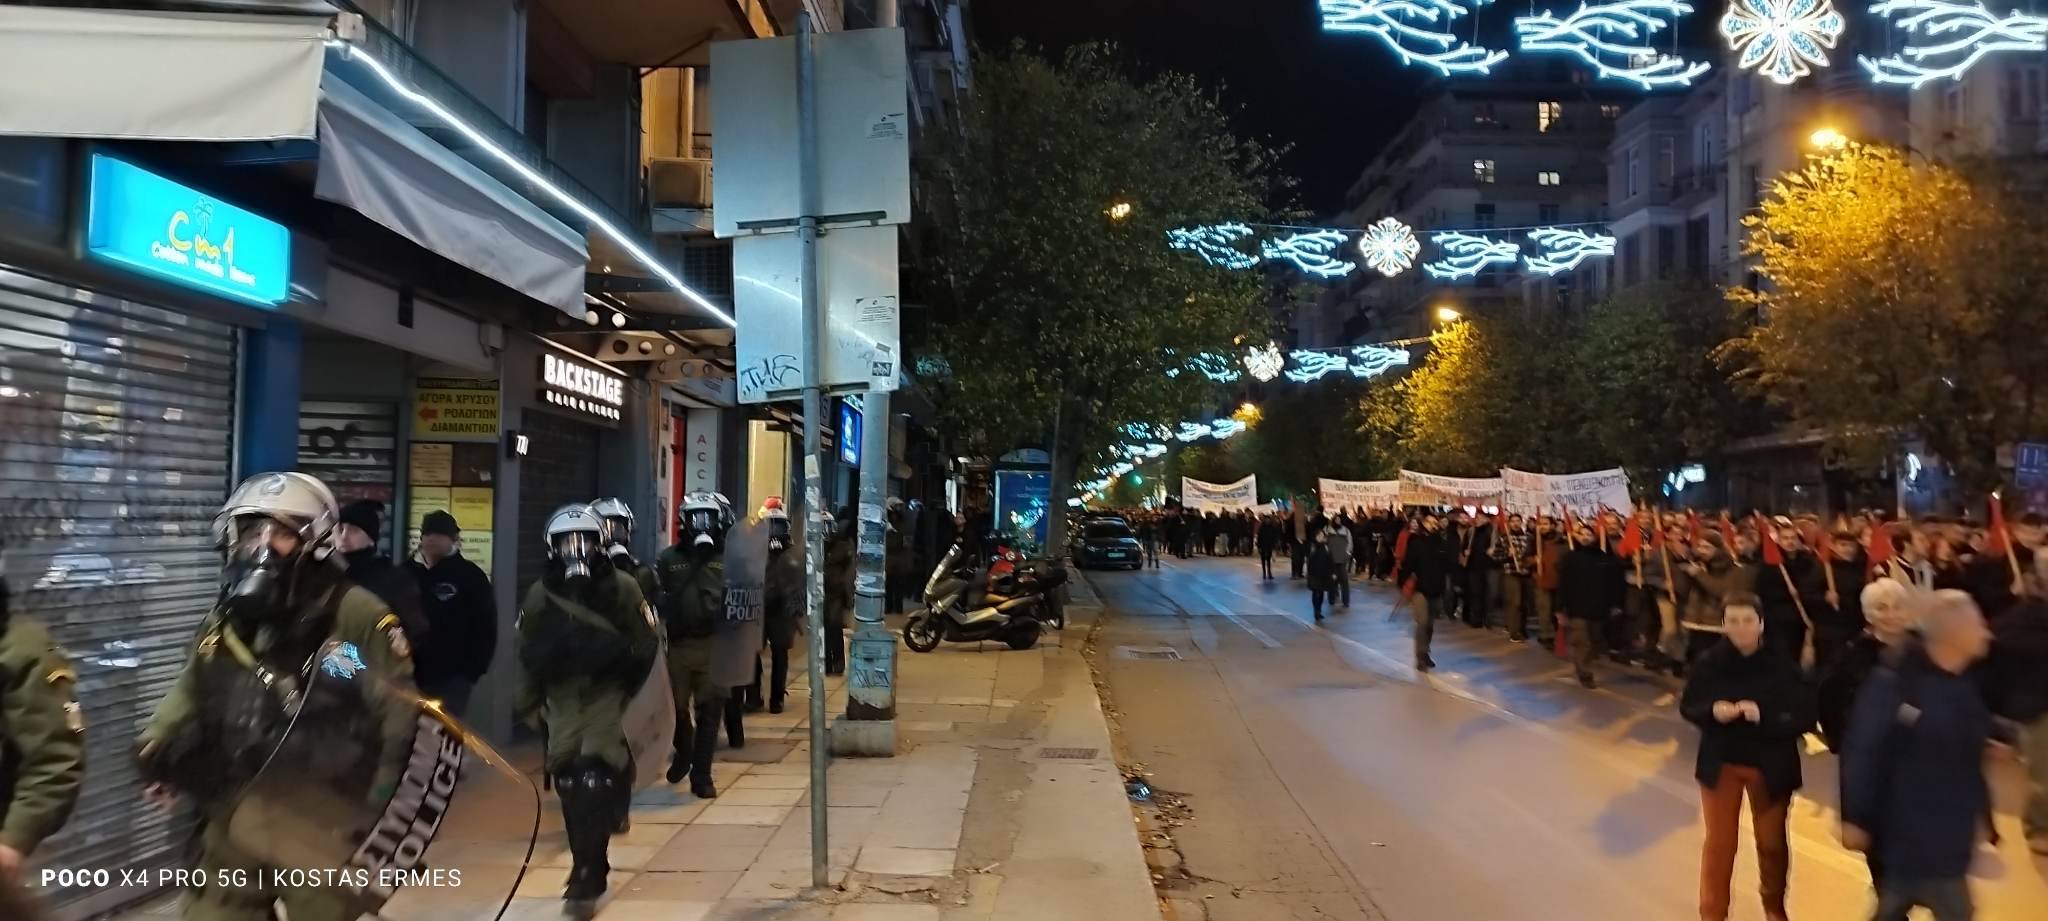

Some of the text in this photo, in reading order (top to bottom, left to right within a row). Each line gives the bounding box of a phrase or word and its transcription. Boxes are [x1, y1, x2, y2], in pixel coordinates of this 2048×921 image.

[544, 353, 623, 406] BACKSTAGE
[418, 393, 496, 405] ΑΓΟΡΑ ΧΡΥΣΟΥ
